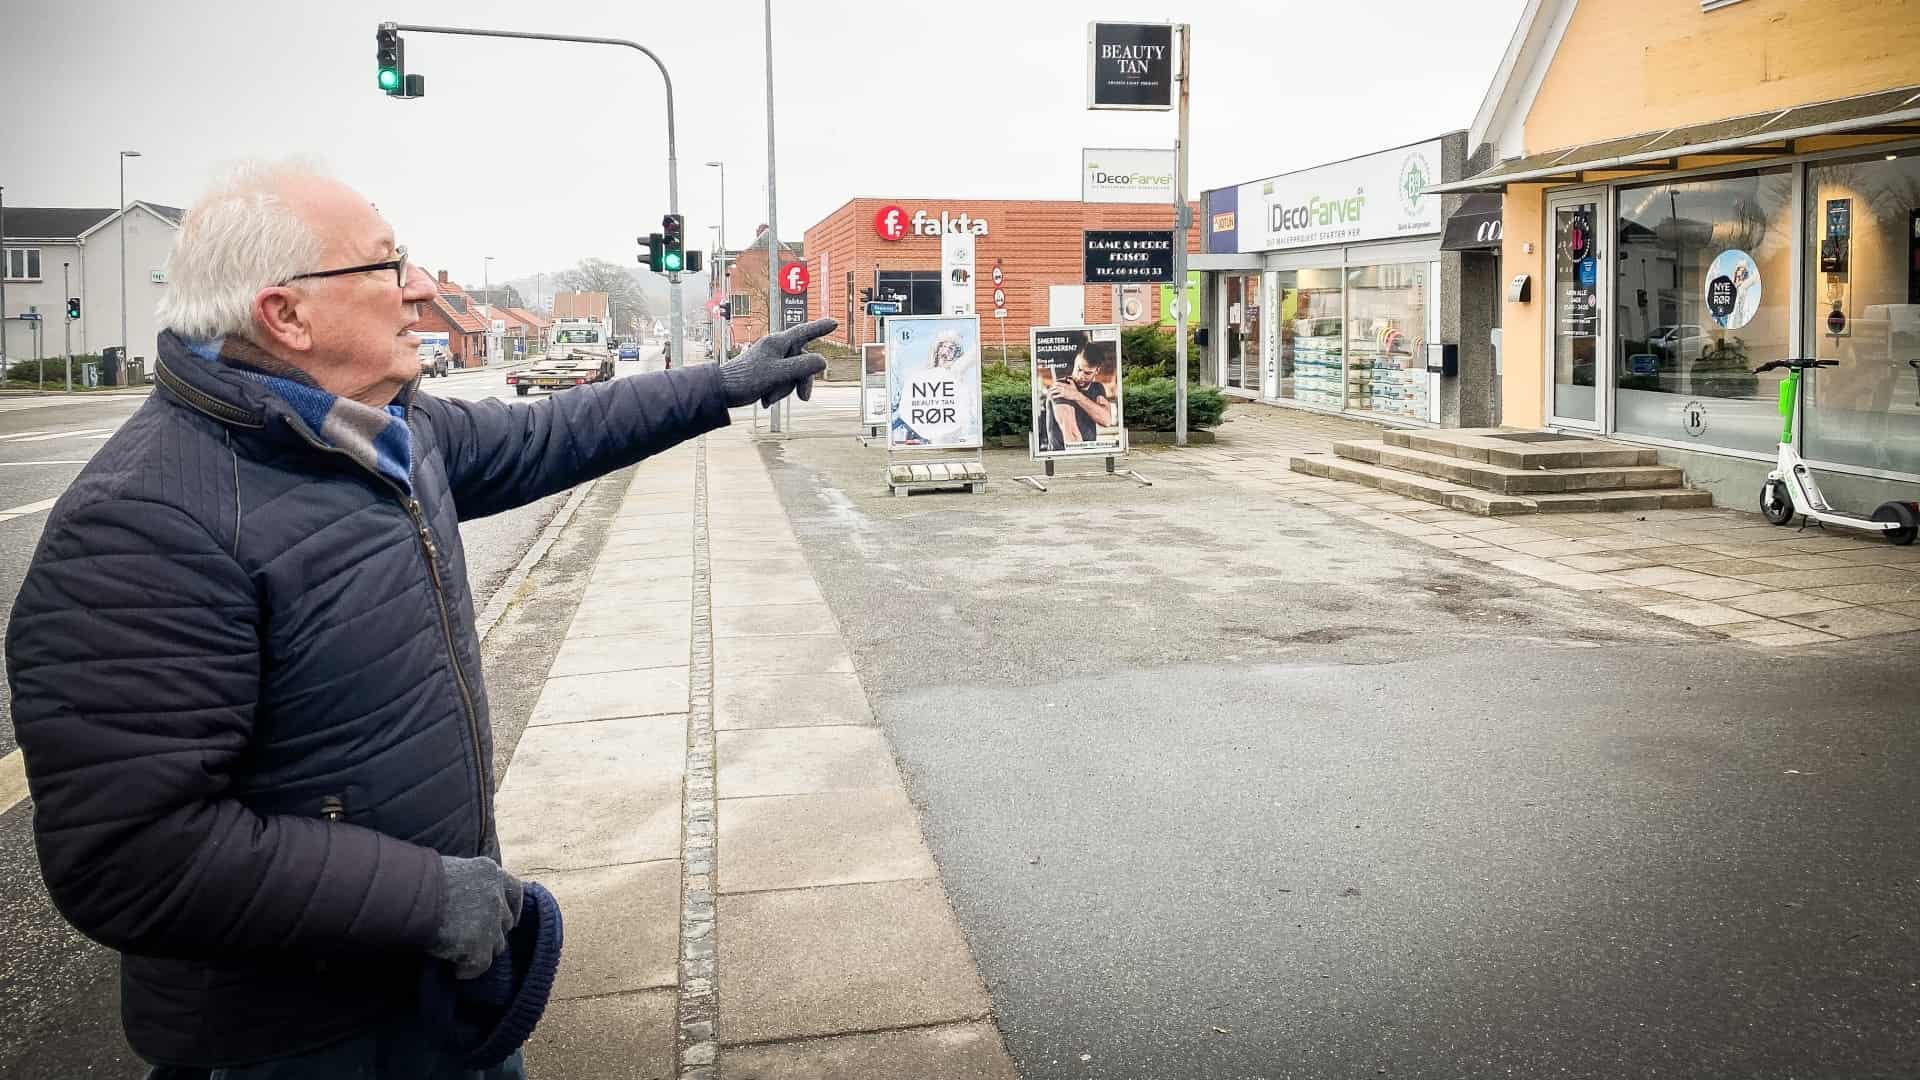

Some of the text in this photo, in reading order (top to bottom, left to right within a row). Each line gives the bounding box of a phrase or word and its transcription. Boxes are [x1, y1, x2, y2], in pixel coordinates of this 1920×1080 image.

[1101, 44, 1165, 59] BEAUTY
[1117, 59, 1149, 73] TAN
[911, 210, 988, 236] fakta
[1088, 240, 1170, 249] DAME & HERRE
[1714, 282, 1731, 291] NYE
[1713, 295, 1730, 305] RØR
[912, 381, 955, 398] NYE
[911, 408, 957, 424] RØR
